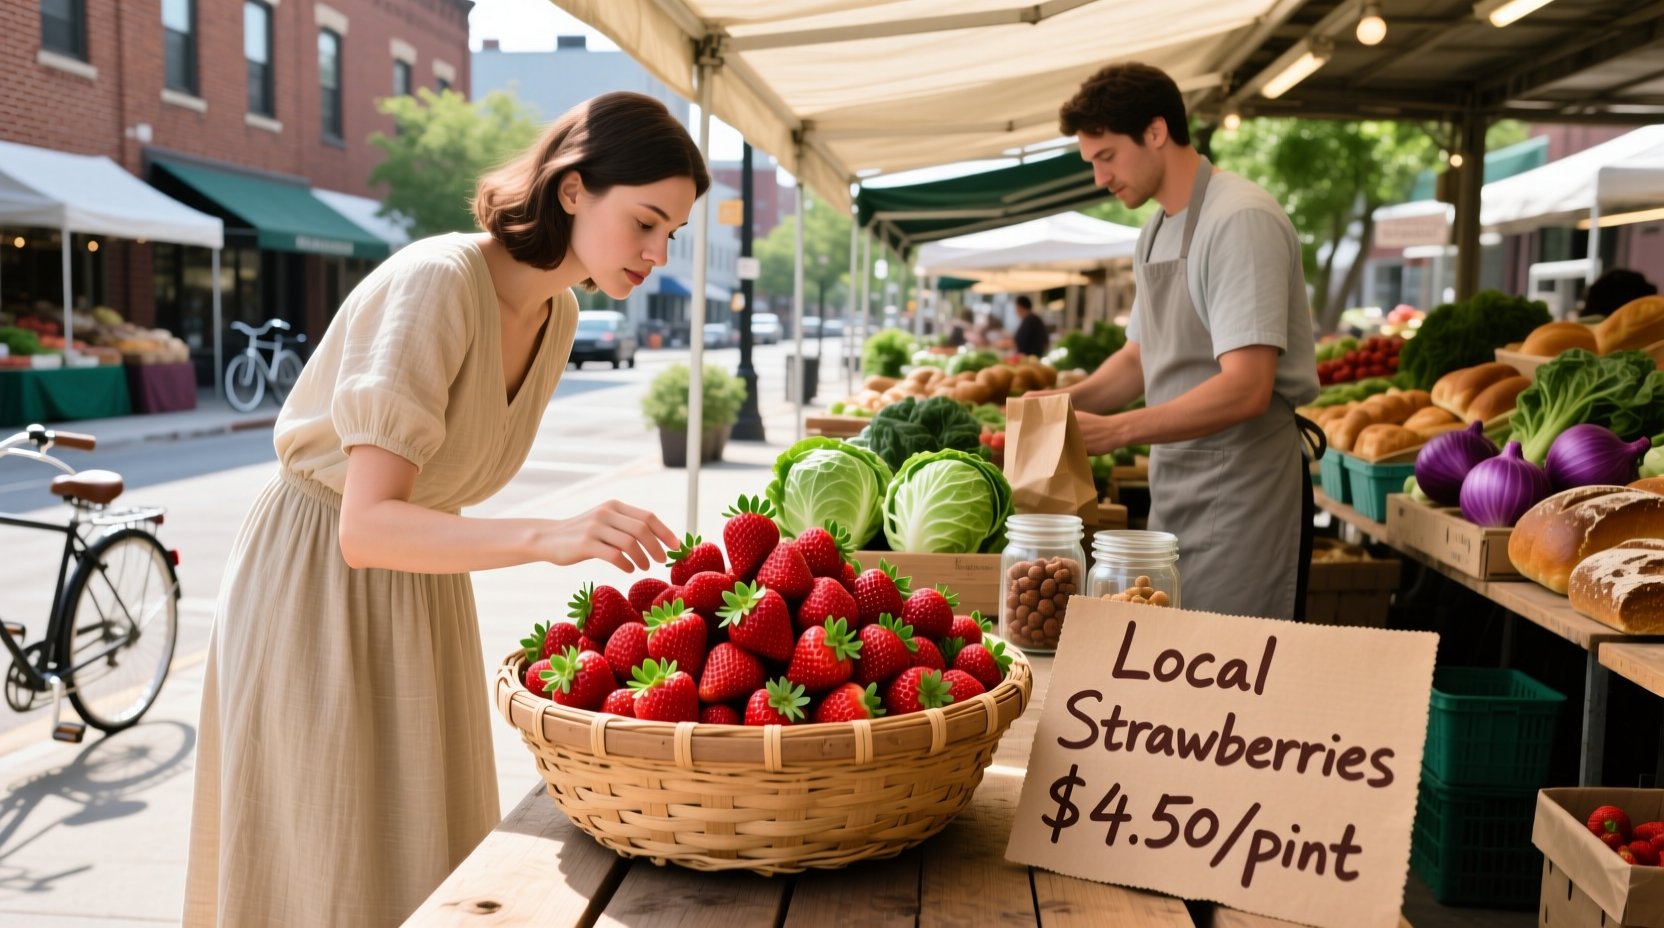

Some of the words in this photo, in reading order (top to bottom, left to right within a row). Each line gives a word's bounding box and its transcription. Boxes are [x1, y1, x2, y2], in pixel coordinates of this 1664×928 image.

[1112, 621, 1277, 695] Local
[1057, 690, 1394, 788] Strawberries
[1041, 764, 1362, 888] $4.50/pint
